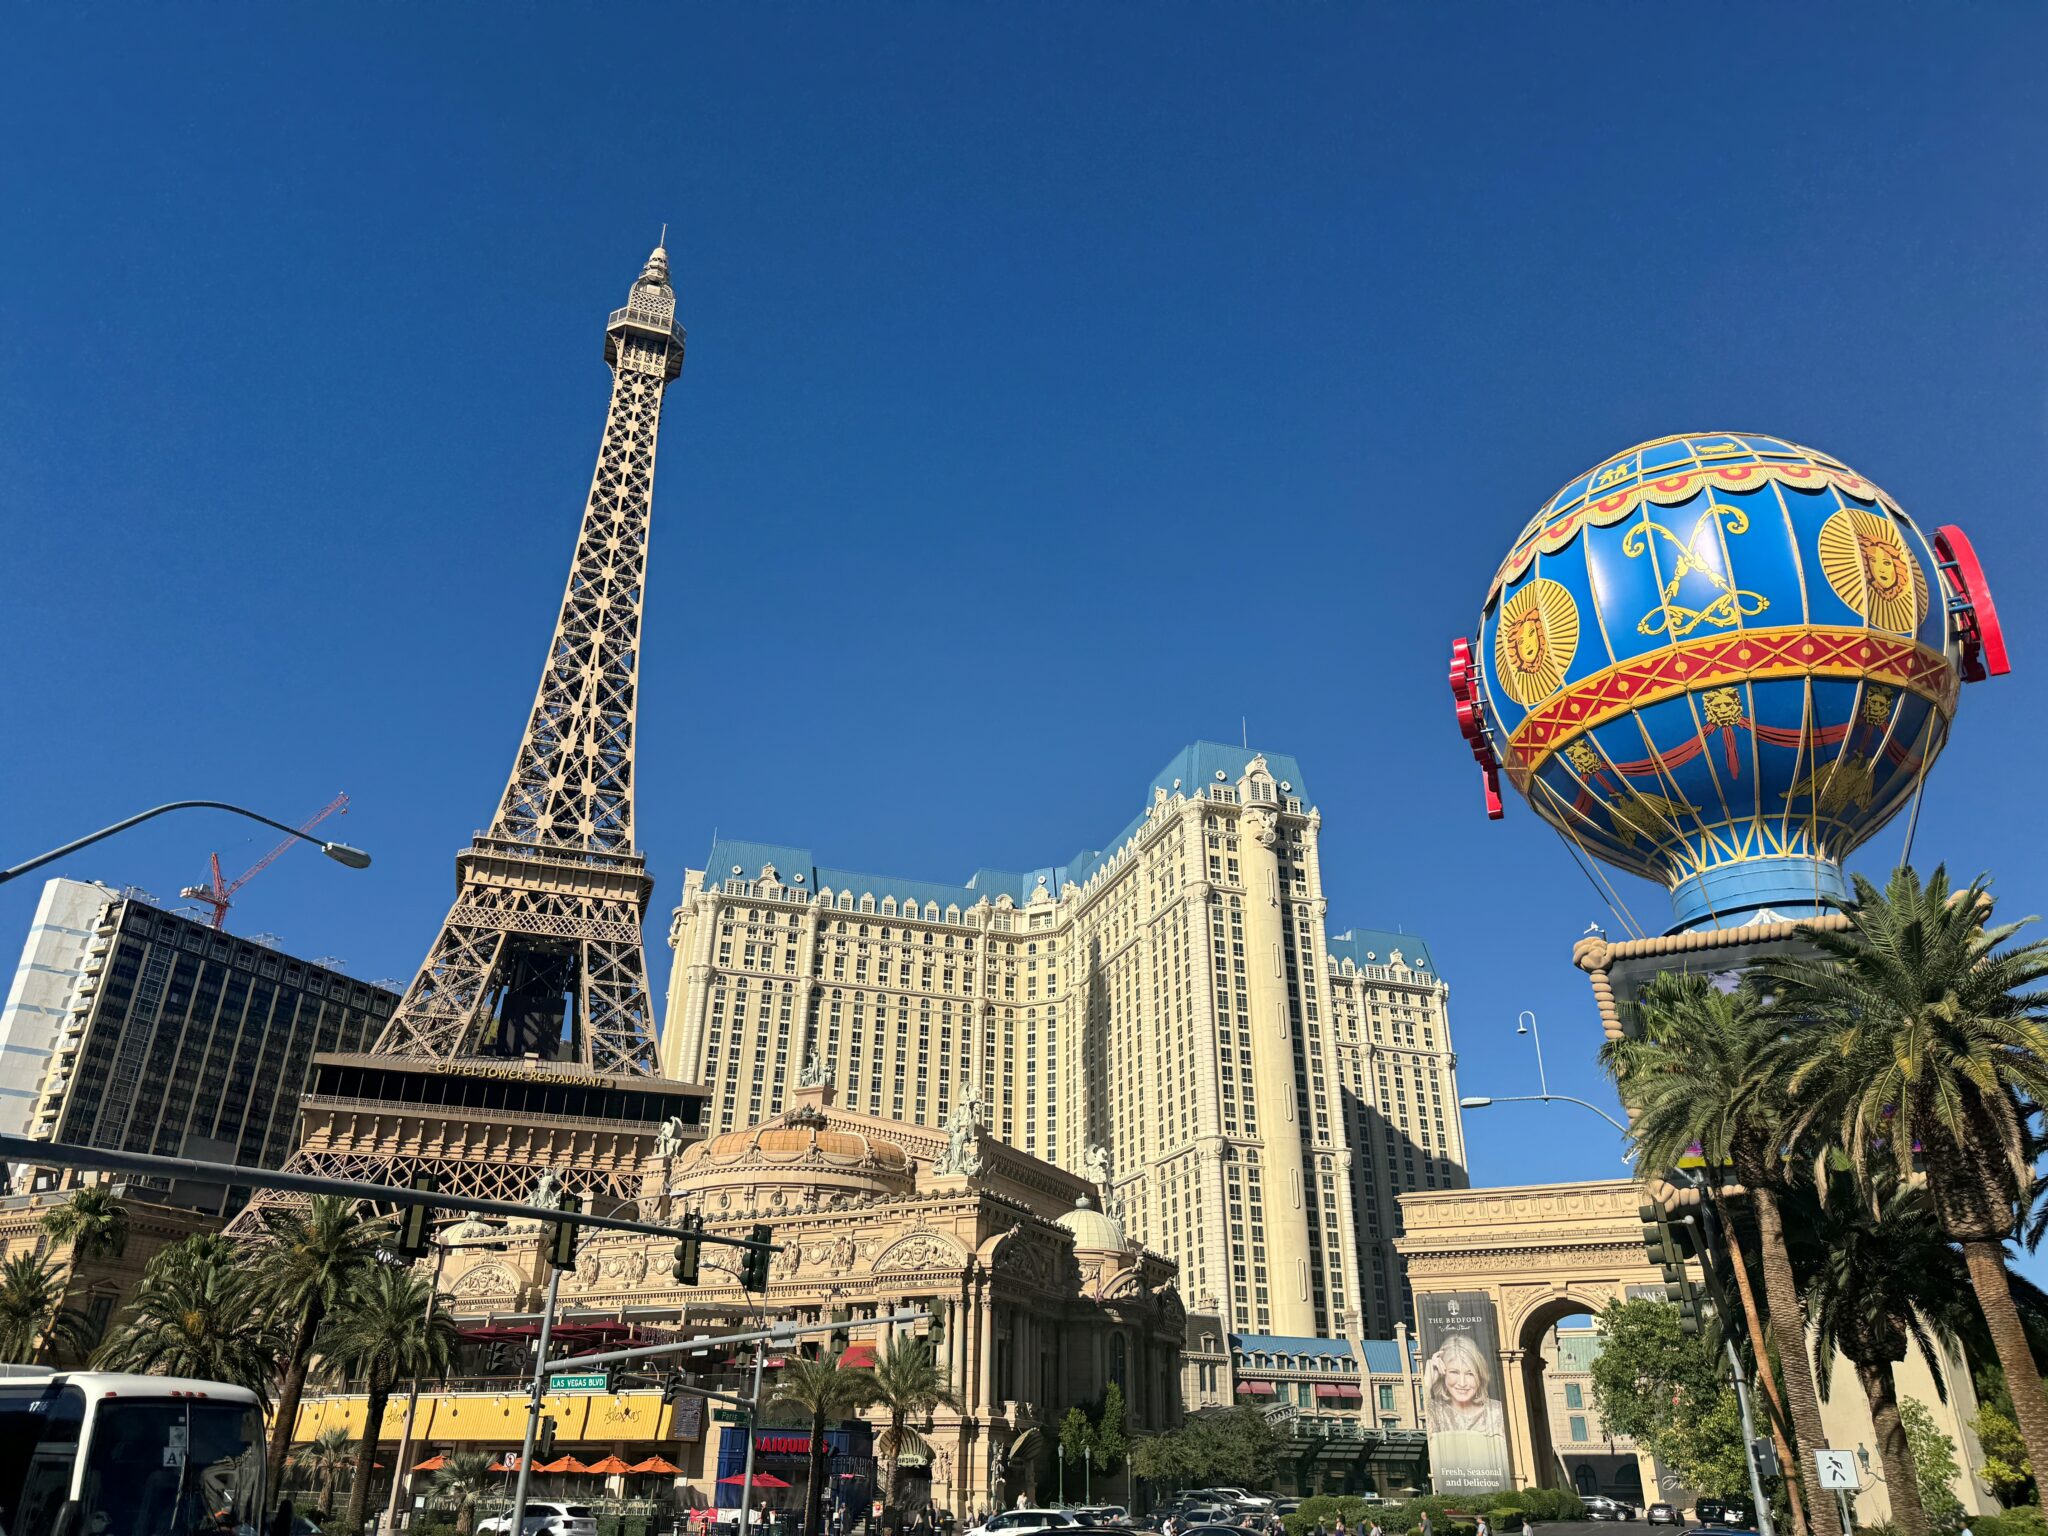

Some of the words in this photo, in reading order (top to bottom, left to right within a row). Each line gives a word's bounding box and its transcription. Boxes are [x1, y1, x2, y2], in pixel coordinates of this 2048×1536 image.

[435, 1063, 478, 1076] EIFFEL
[481, 1066, 524, 1080] TOWER
[529, 1070, 604, 1087] RESTAURANT
[610, 1298, 651, 1306] ACADEMIE
[667, 1294, 715, 1303] NATIONALE
[1445, 1316, 1482, 1324] BEDFORD
[552, 1379, 565, 1388] LAS
[567, 1378, 587, 1387] VEGAS
[588, 1378, 604, 1387] BLVD
[721, 1411, 738, 1421] Paris
[166, 1452, 178, 1465] A
[1441, 1467, 1466, 1477] Fresh,
[1467, 1467, 1502, 1476] Seasonal
[1445, 1478, 1462, 1487] and
[1463, 1478, 1500, 1487] Delicious
